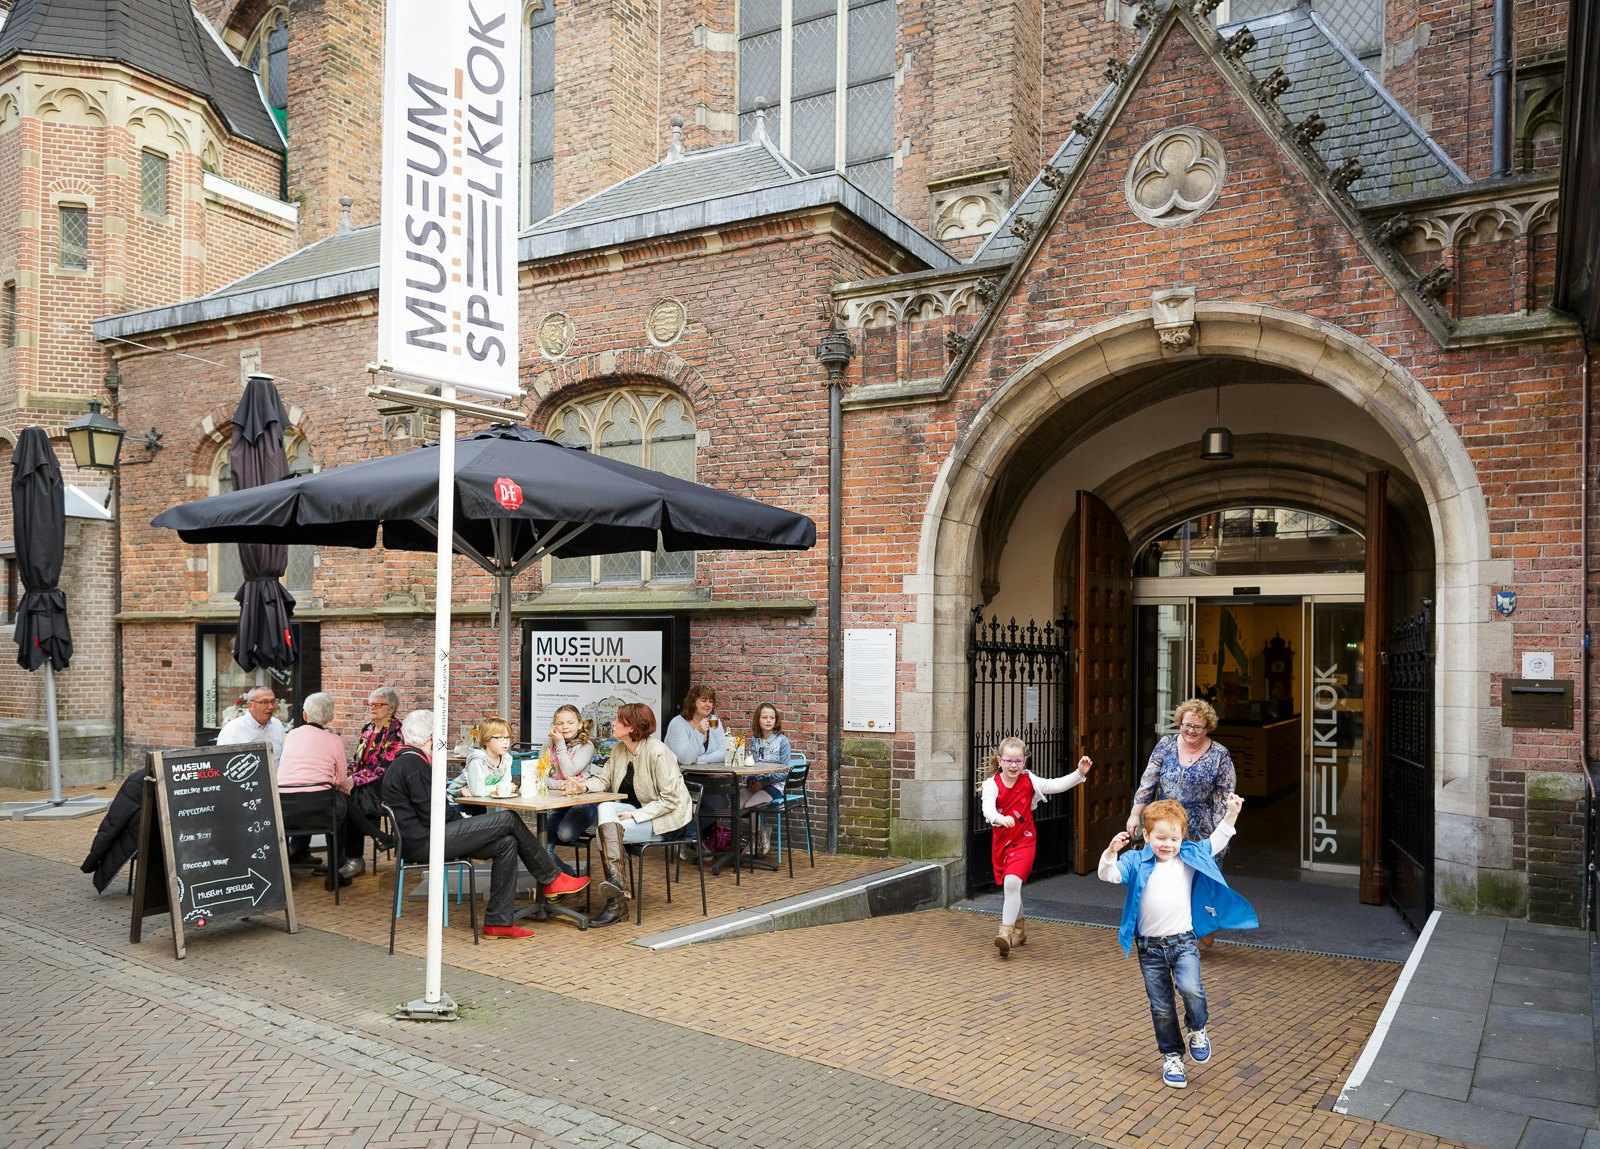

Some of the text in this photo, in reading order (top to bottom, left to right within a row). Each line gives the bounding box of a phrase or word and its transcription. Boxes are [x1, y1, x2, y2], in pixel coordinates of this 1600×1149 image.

[405, 72, 448, 352] MUSEUM
[537, 637, 624, 657] MUSEUM
[171, 761, 211, 773] MUSEUM
[197, 888, 224, 900] MUSEUM
